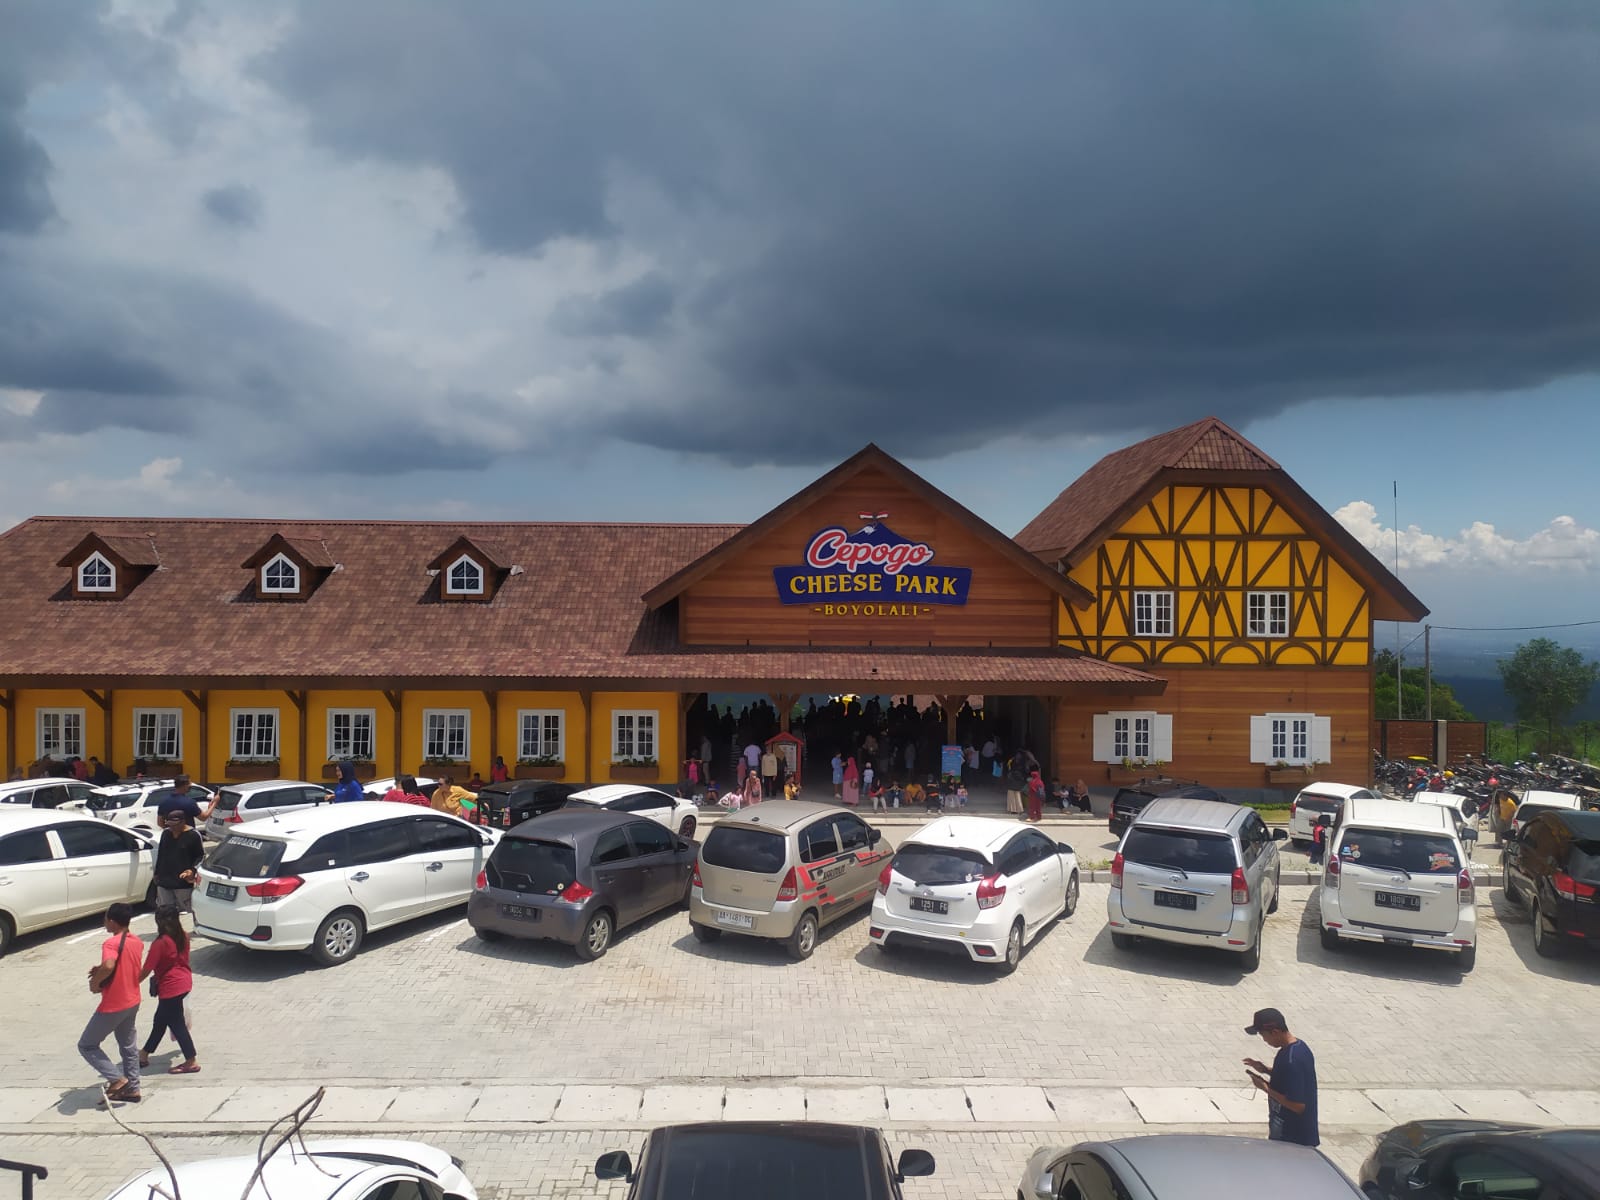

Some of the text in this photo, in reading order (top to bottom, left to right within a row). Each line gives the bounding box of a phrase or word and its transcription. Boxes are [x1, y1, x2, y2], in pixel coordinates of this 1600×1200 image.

[807, 529, 935, 575] Cepogo
[789, 574, 958, 595] CHEESE PARK
